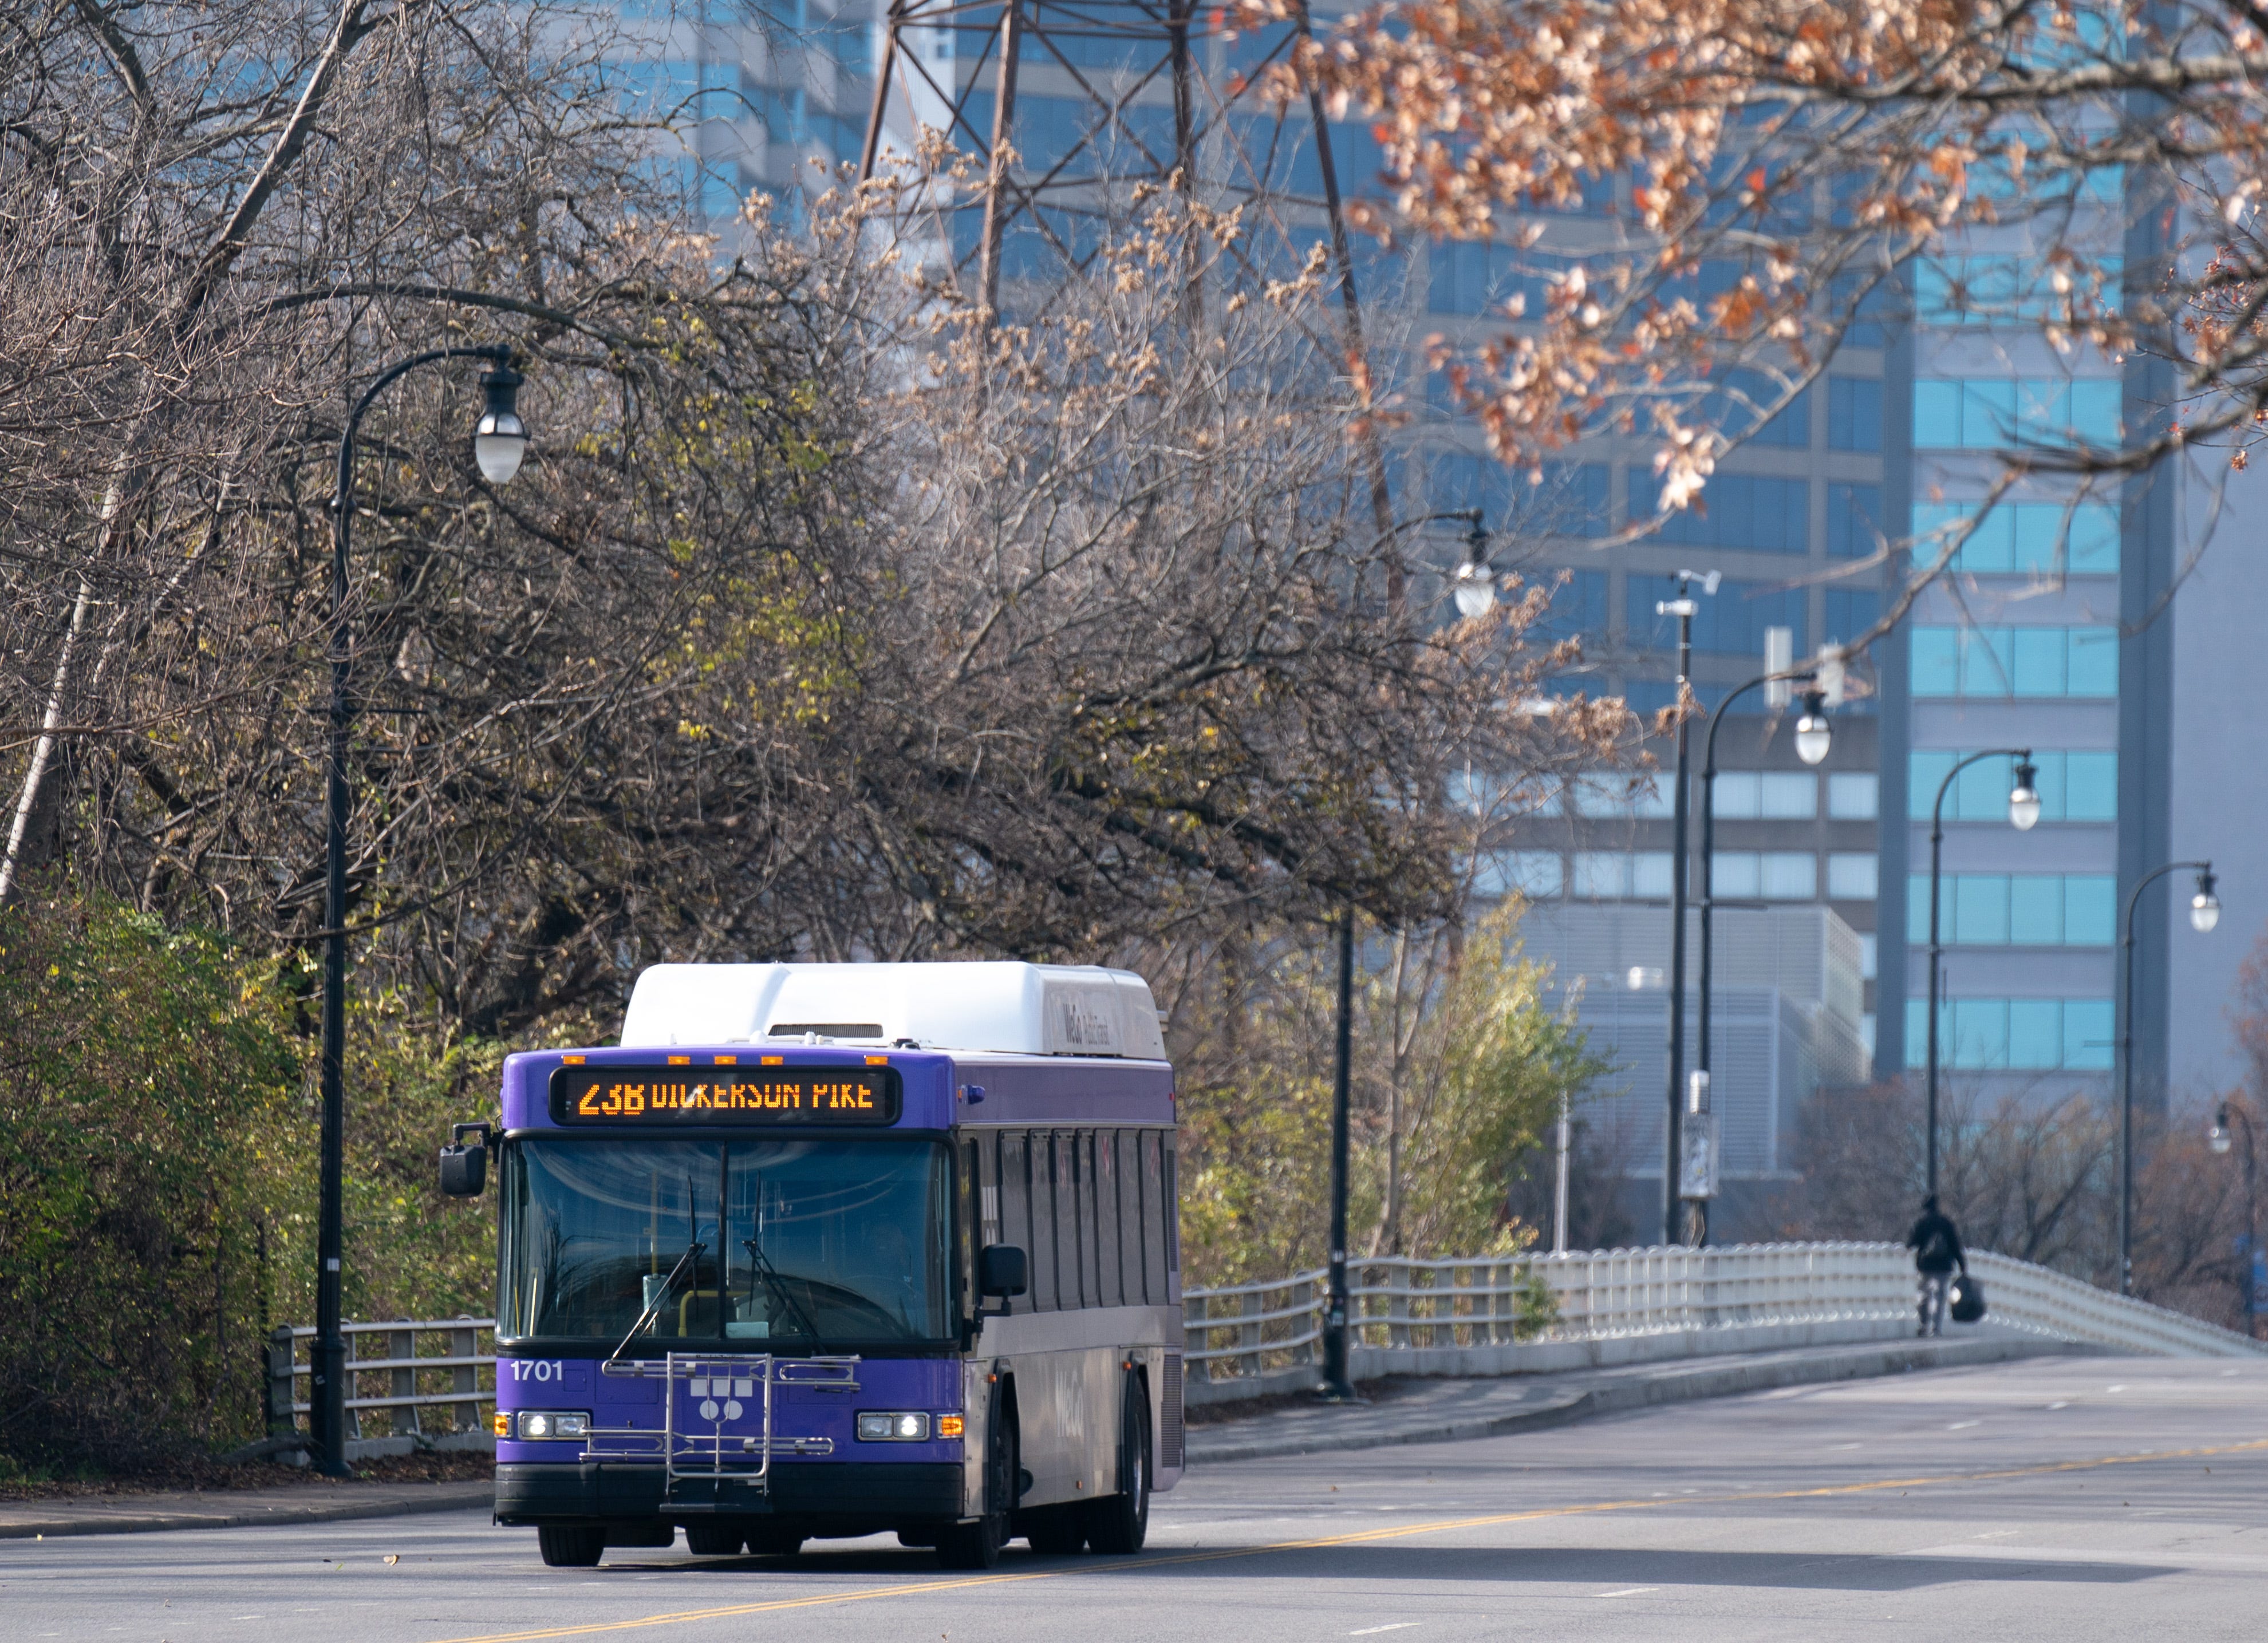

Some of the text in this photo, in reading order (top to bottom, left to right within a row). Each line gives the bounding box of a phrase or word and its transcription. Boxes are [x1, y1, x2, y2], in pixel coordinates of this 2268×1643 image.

[812, 1084, 873, 1108] PIKE
[510, 1360, 562, 1381] 1701
[1055, 1369, 1083, 1438] WeGo
